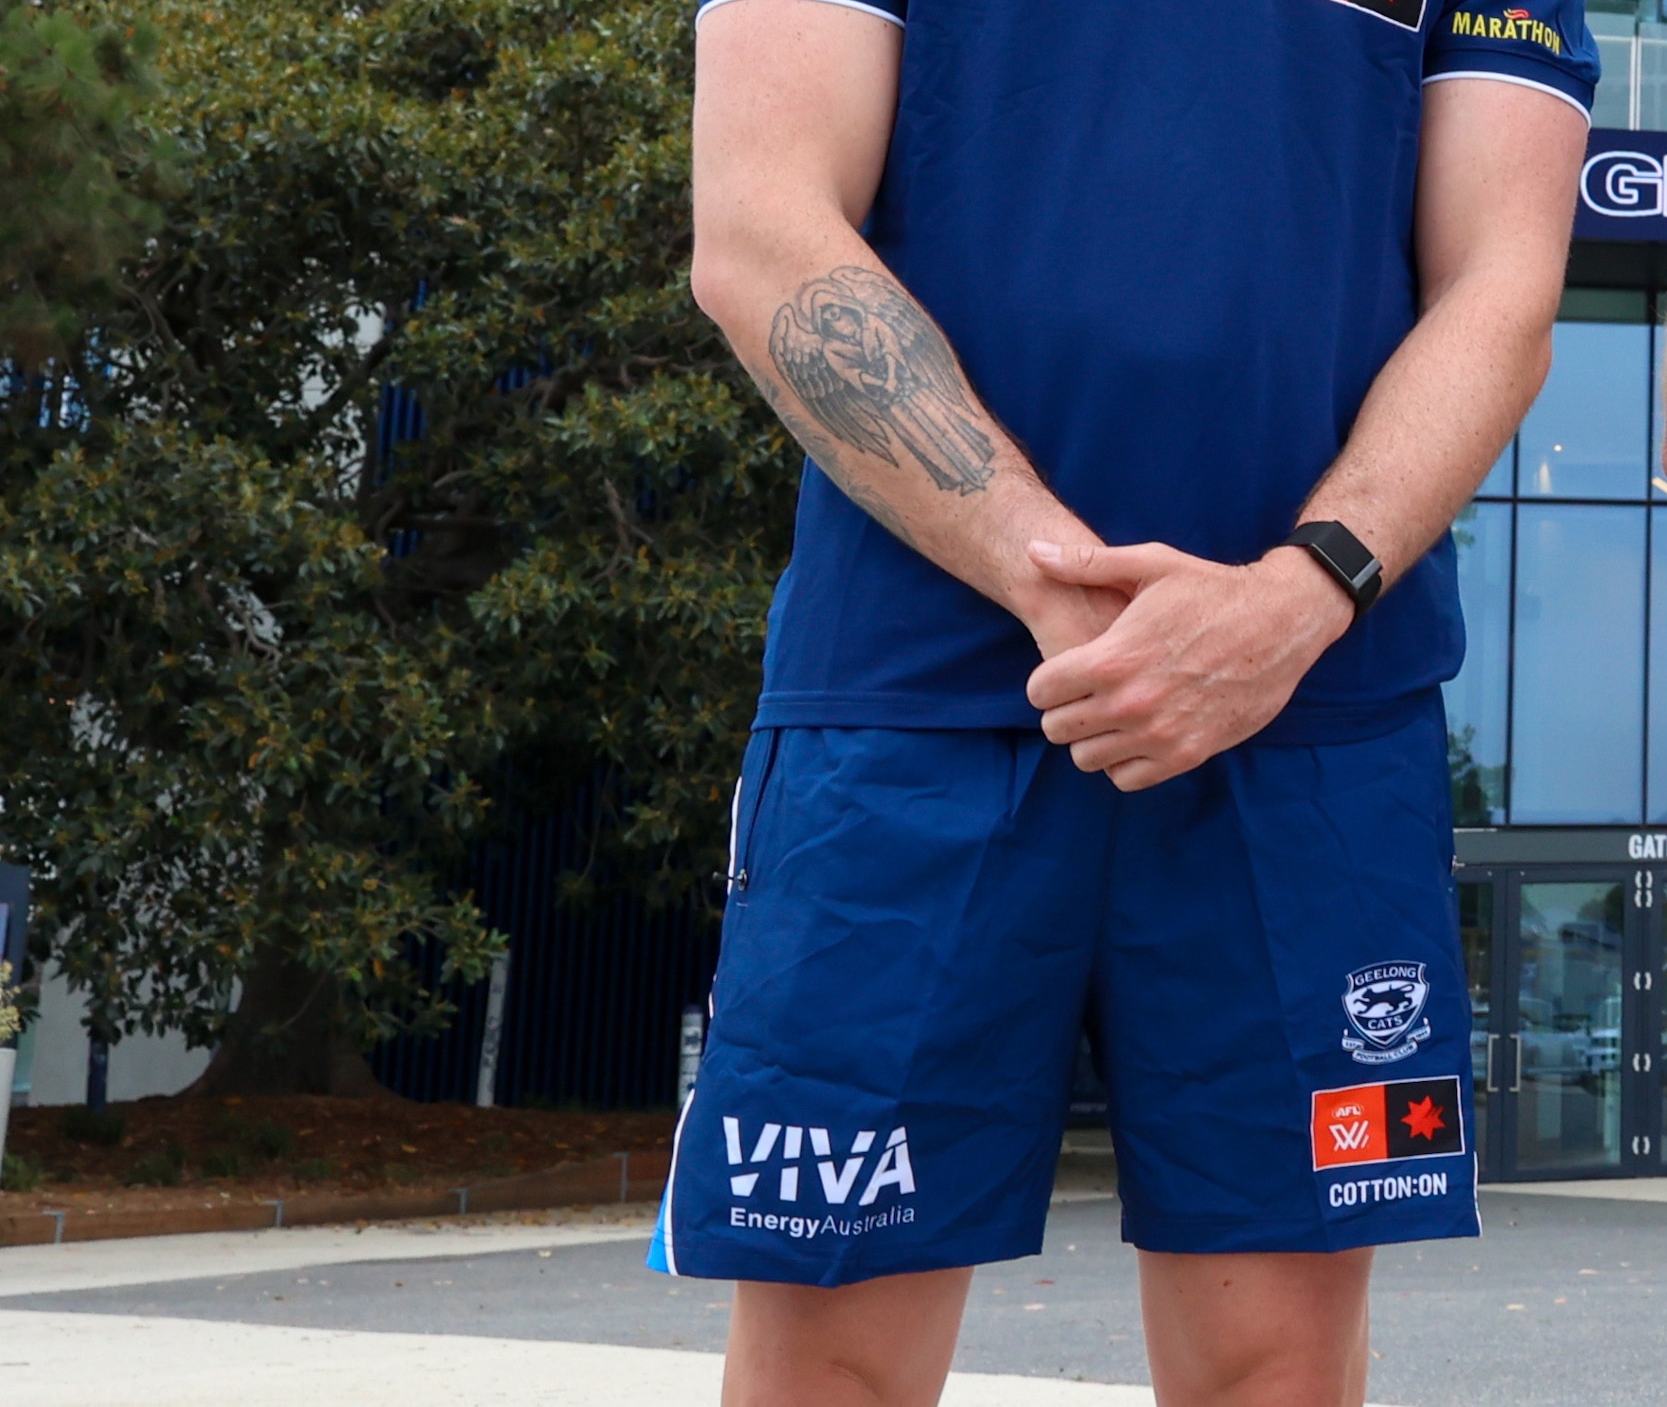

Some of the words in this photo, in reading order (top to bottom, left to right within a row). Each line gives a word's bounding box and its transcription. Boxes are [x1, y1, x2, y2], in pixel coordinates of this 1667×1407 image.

[1453, 11, 1560, 54] MARATHON
[1354, 966, 1417, 987] GEELONG
[1367, 1015, 1403, 1030] CATS
[1334, 1106, 1361, 1116] AFL
[723, 1116, 916, 1206] VIVA
[1329, 1173, 1447, 1207] COTTON:ON
[730, 1205, 915, 1239] EnergyAustralia
